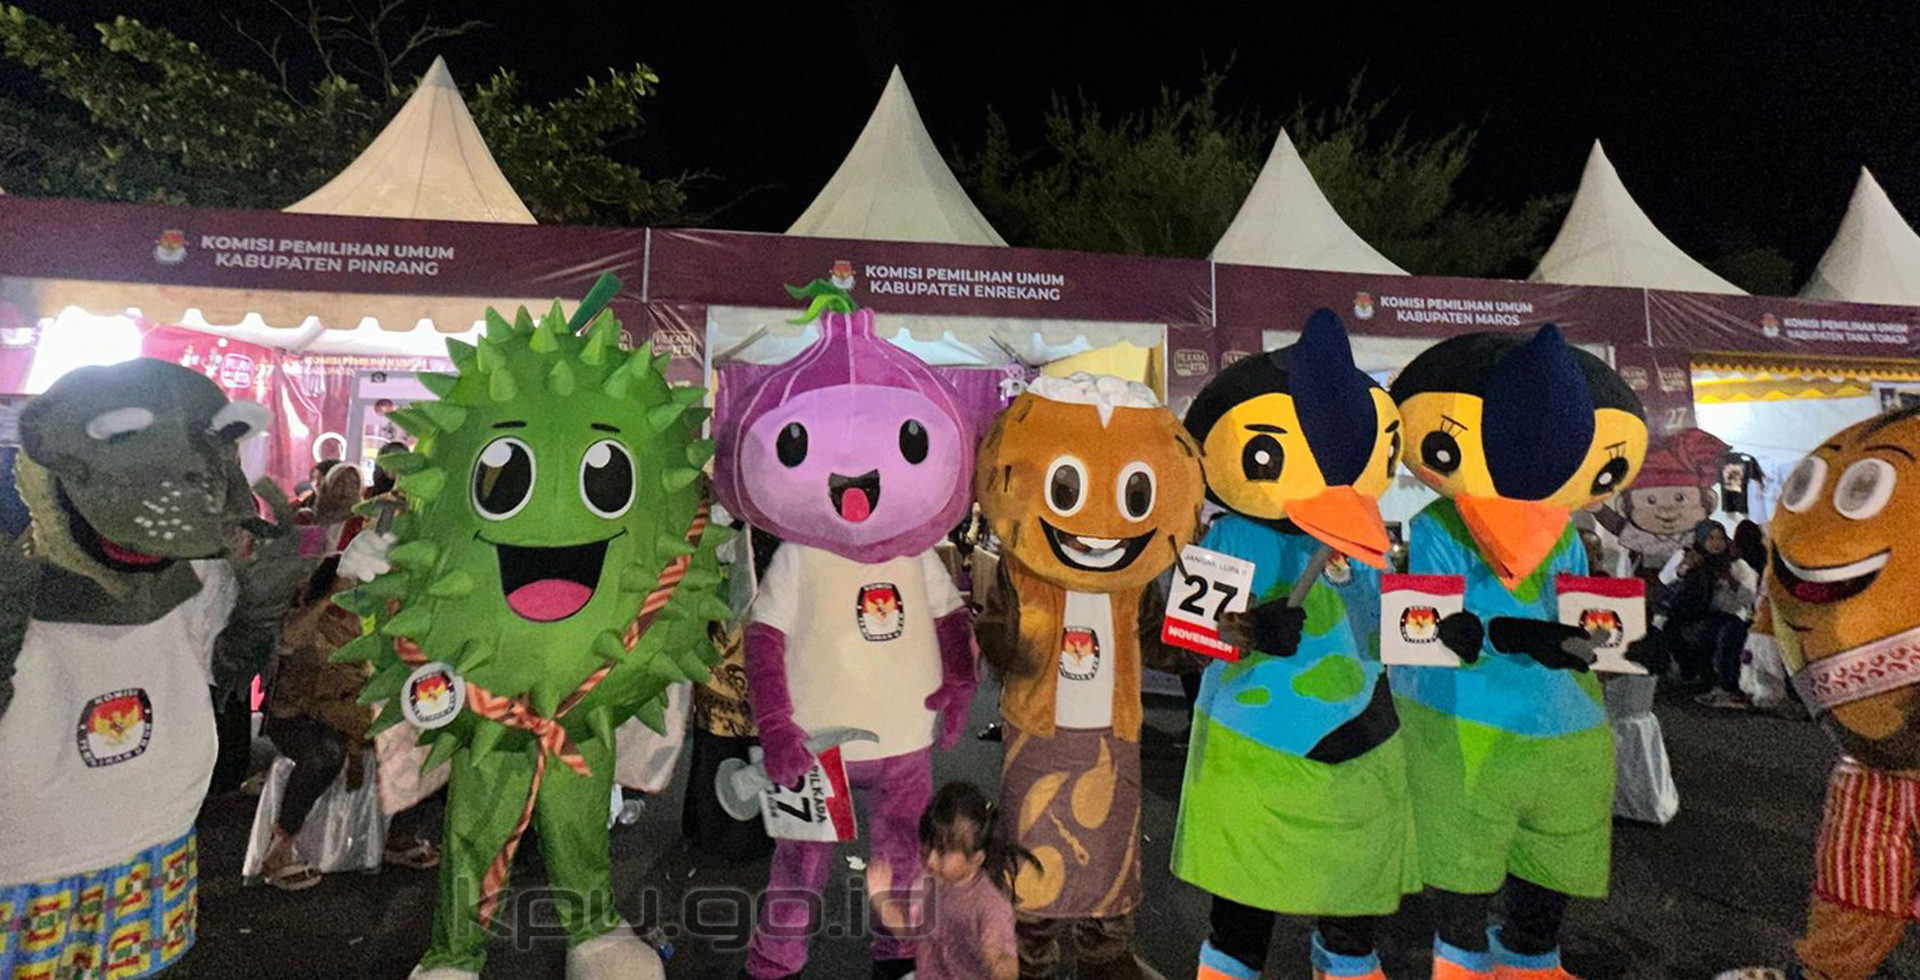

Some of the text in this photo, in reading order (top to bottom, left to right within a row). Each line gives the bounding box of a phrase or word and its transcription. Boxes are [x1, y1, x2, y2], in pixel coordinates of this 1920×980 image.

[201, 235, 454, 260] KOMISI PEMILIHAN UMUM
[215, 252, 439, 276] KABUPATEN PINRANG
[865, 264, 1064, 287] KOMISI PEMILIHAN UMUM
[870, 280, 1061, 301] KABUPATEN ENREKANG
[1380, 296, 1533, 314] KOMISI PEMILIHAN UMUM
[1396, 310, 1521, 326] KABUPATEN MAROS
[1783, 318, 1820, 328] KOMISI
[1821, 319, 1877, 332] PEMILIHAN
[1665, 407, 1687, 429] 27
[1219, 563, 1240, 575] LUPA
[1179, 575, 1238, 622] 27
[1167, 625, 1233, 654] NOVEMBER
[809, 765, 828, 824] PILKADA
